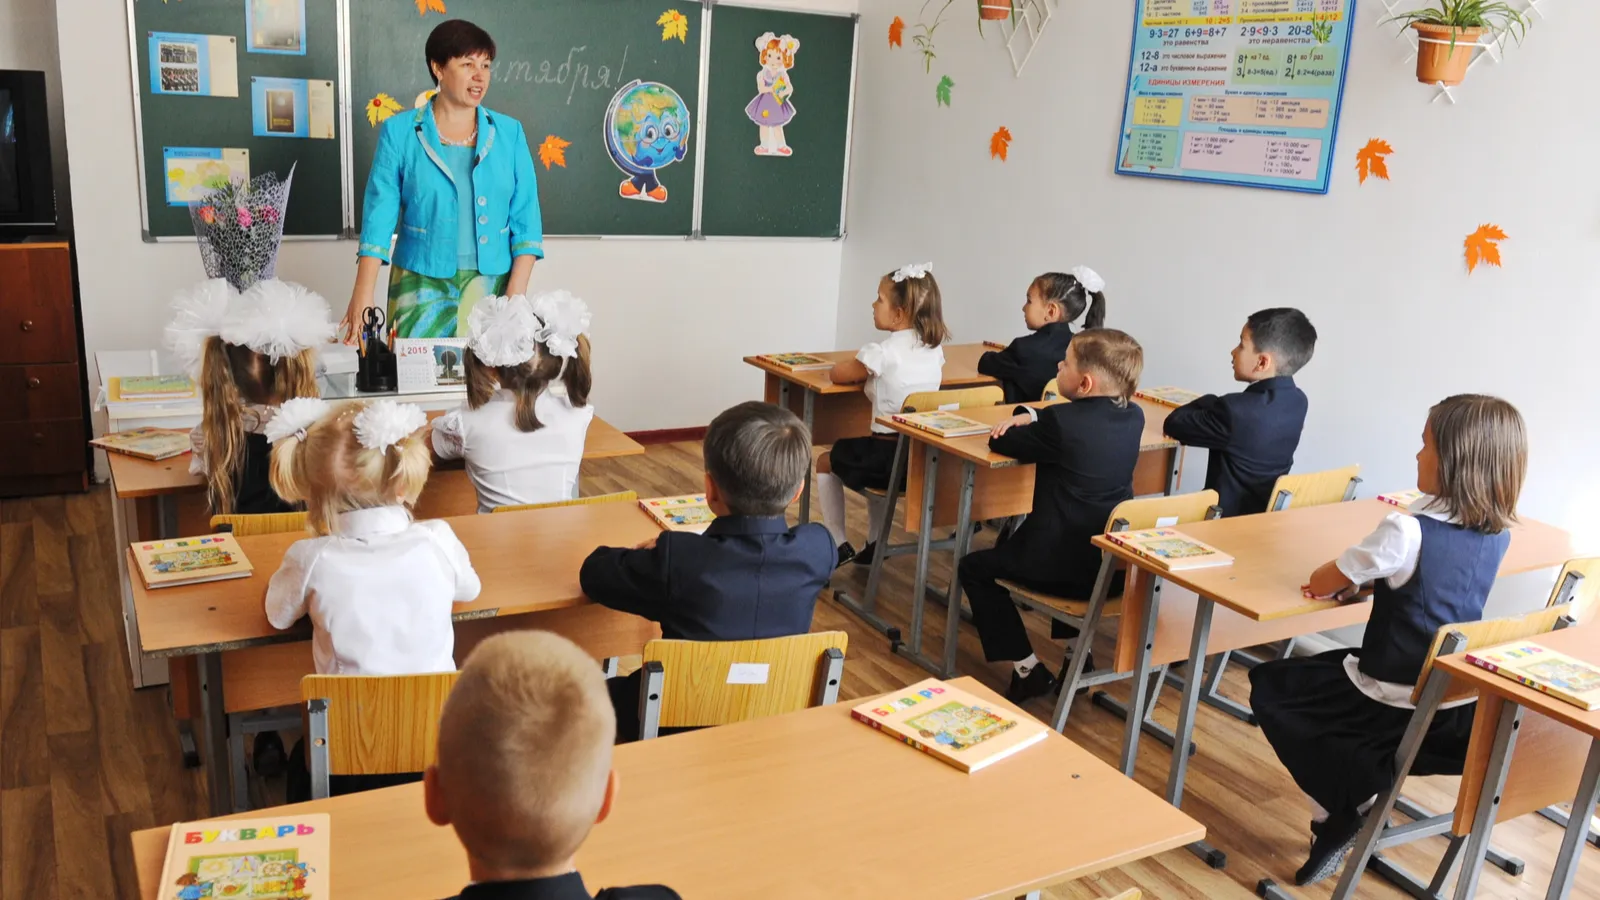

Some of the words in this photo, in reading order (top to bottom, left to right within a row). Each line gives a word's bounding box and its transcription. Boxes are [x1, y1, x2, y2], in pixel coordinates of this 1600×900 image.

[1150, 28, 1179, 38] 9·3=27
[1185, 27, 1227, 38] 6+9=8+7
[1241, 26, 1279, 36] 2·9<9·3
[1141, 51, 1159, 60] 12-8
[1238, 54, 1243, 64] 8
[1287, 54, 1293, 64] 8
[1236, 67, 1242, 76] 3
[1285, 68, 1291, 77] 2
[408, 346, 428, 354] 2015
[872, 686, 946, 717] БУКВАРЬ
[184, 824, 315, 844] БУКВАРЬ
